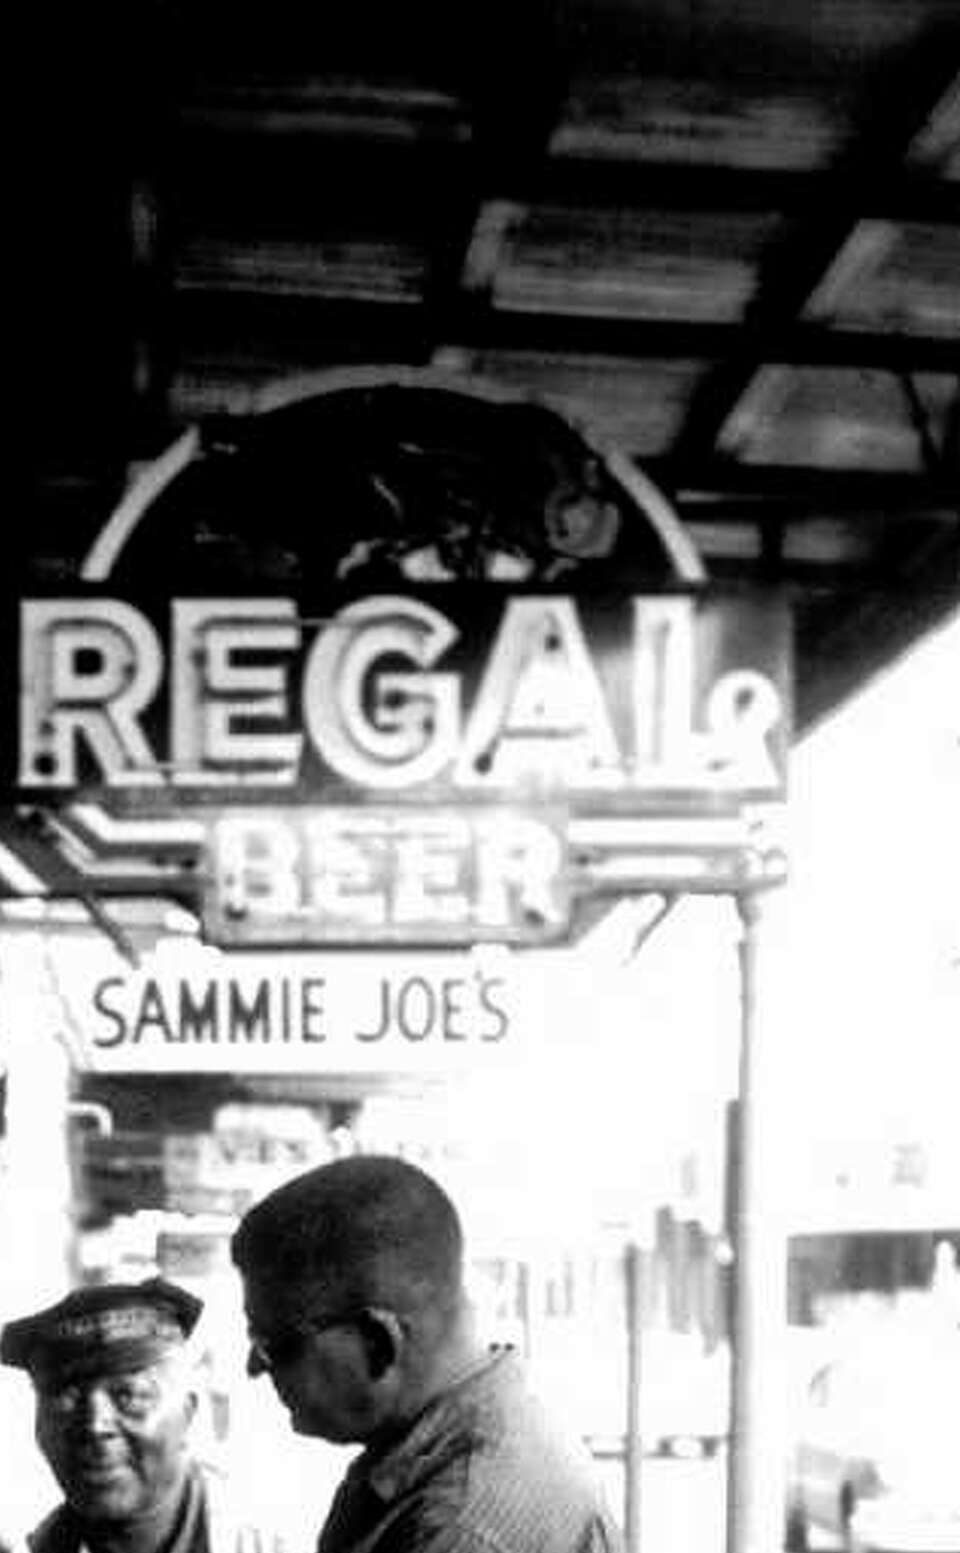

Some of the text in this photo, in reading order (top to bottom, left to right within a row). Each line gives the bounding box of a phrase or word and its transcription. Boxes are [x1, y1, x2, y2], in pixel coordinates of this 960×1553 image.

[18, 596, 782, 789] REGAL
[214, 814, 564, 927] BEER
[92, 969, 511, 1048] SAMMIE JOE'S
